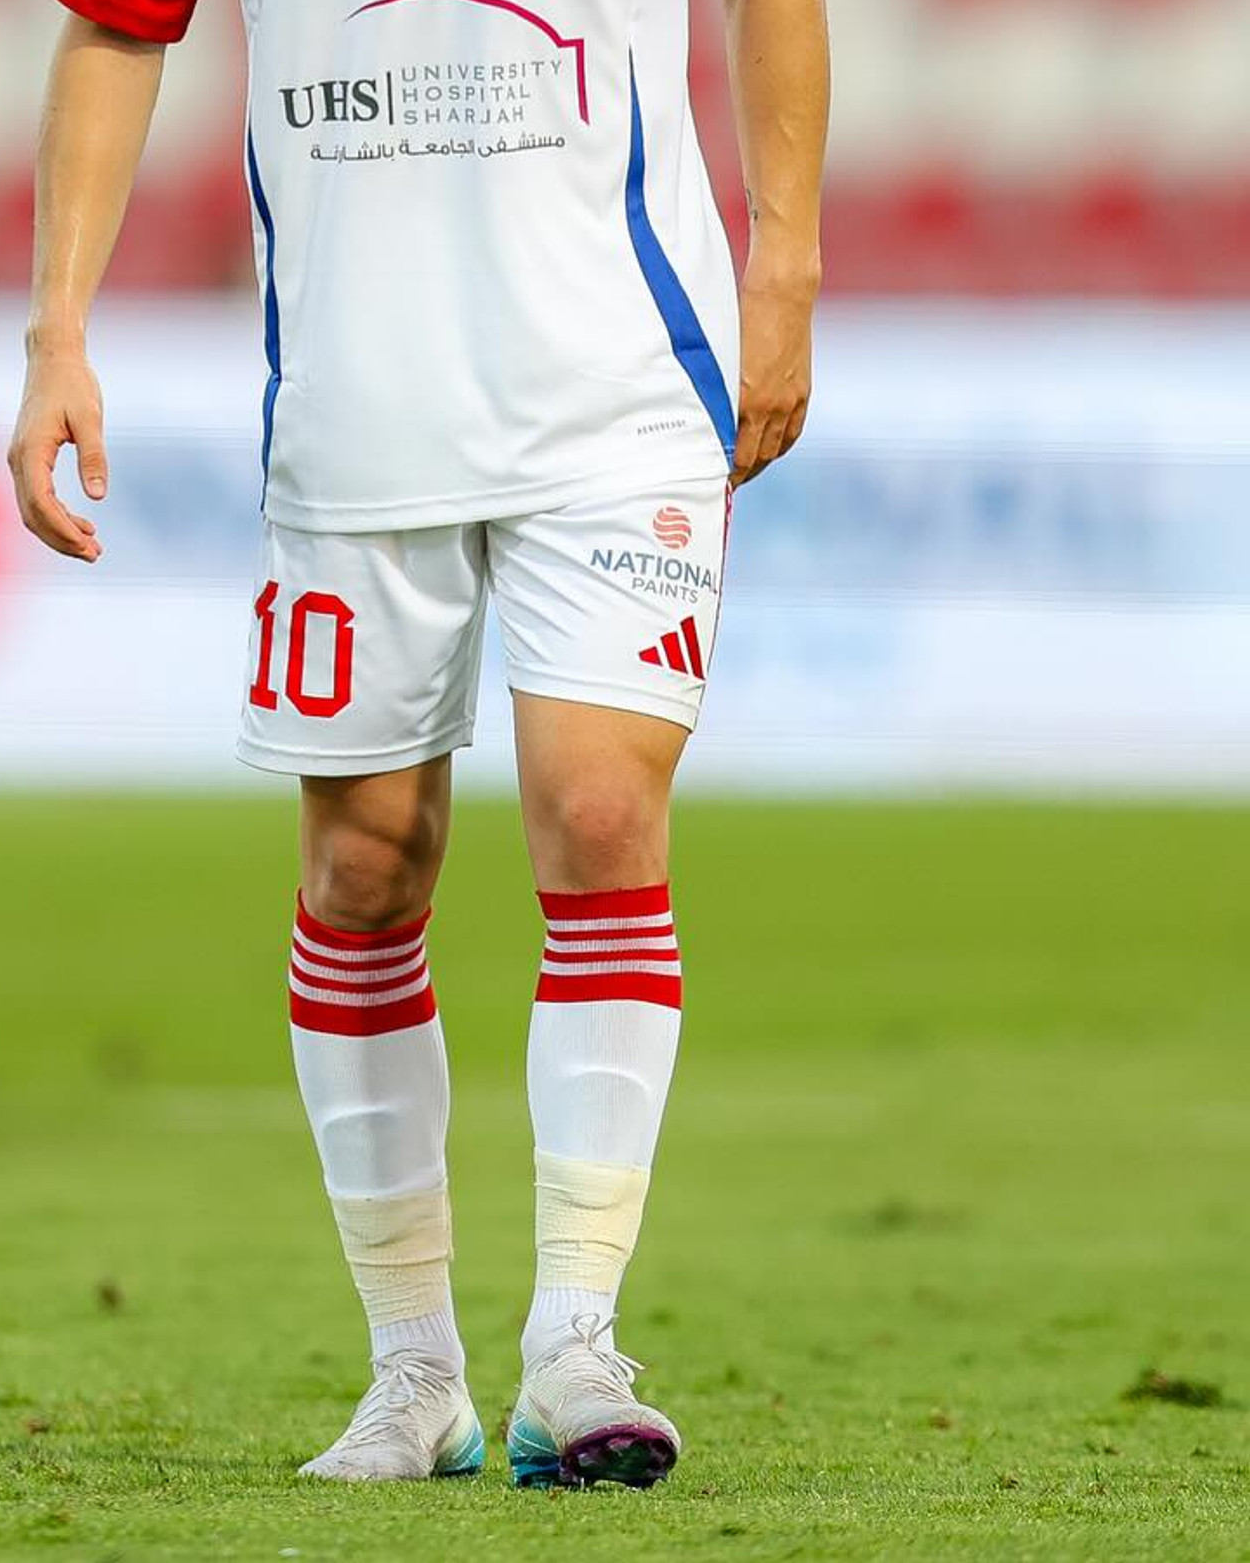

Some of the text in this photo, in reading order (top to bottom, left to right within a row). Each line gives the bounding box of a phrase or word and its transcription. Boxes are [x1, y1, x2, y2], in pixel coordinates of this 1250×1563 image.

[401, 60, 561, 83] UNIVERSITY
[278, 78, 381, 128] UHS
[402, 83, 530, 104] HOSPITAL
[403, 106, 524, 126] SHARJAH
[477, 130, 566, 158] مستشفى
[590, 548, 718, 596] NATIONAL
[631, 576, 699, 605] PAINTS
[249, 580, 357, 719] 10
